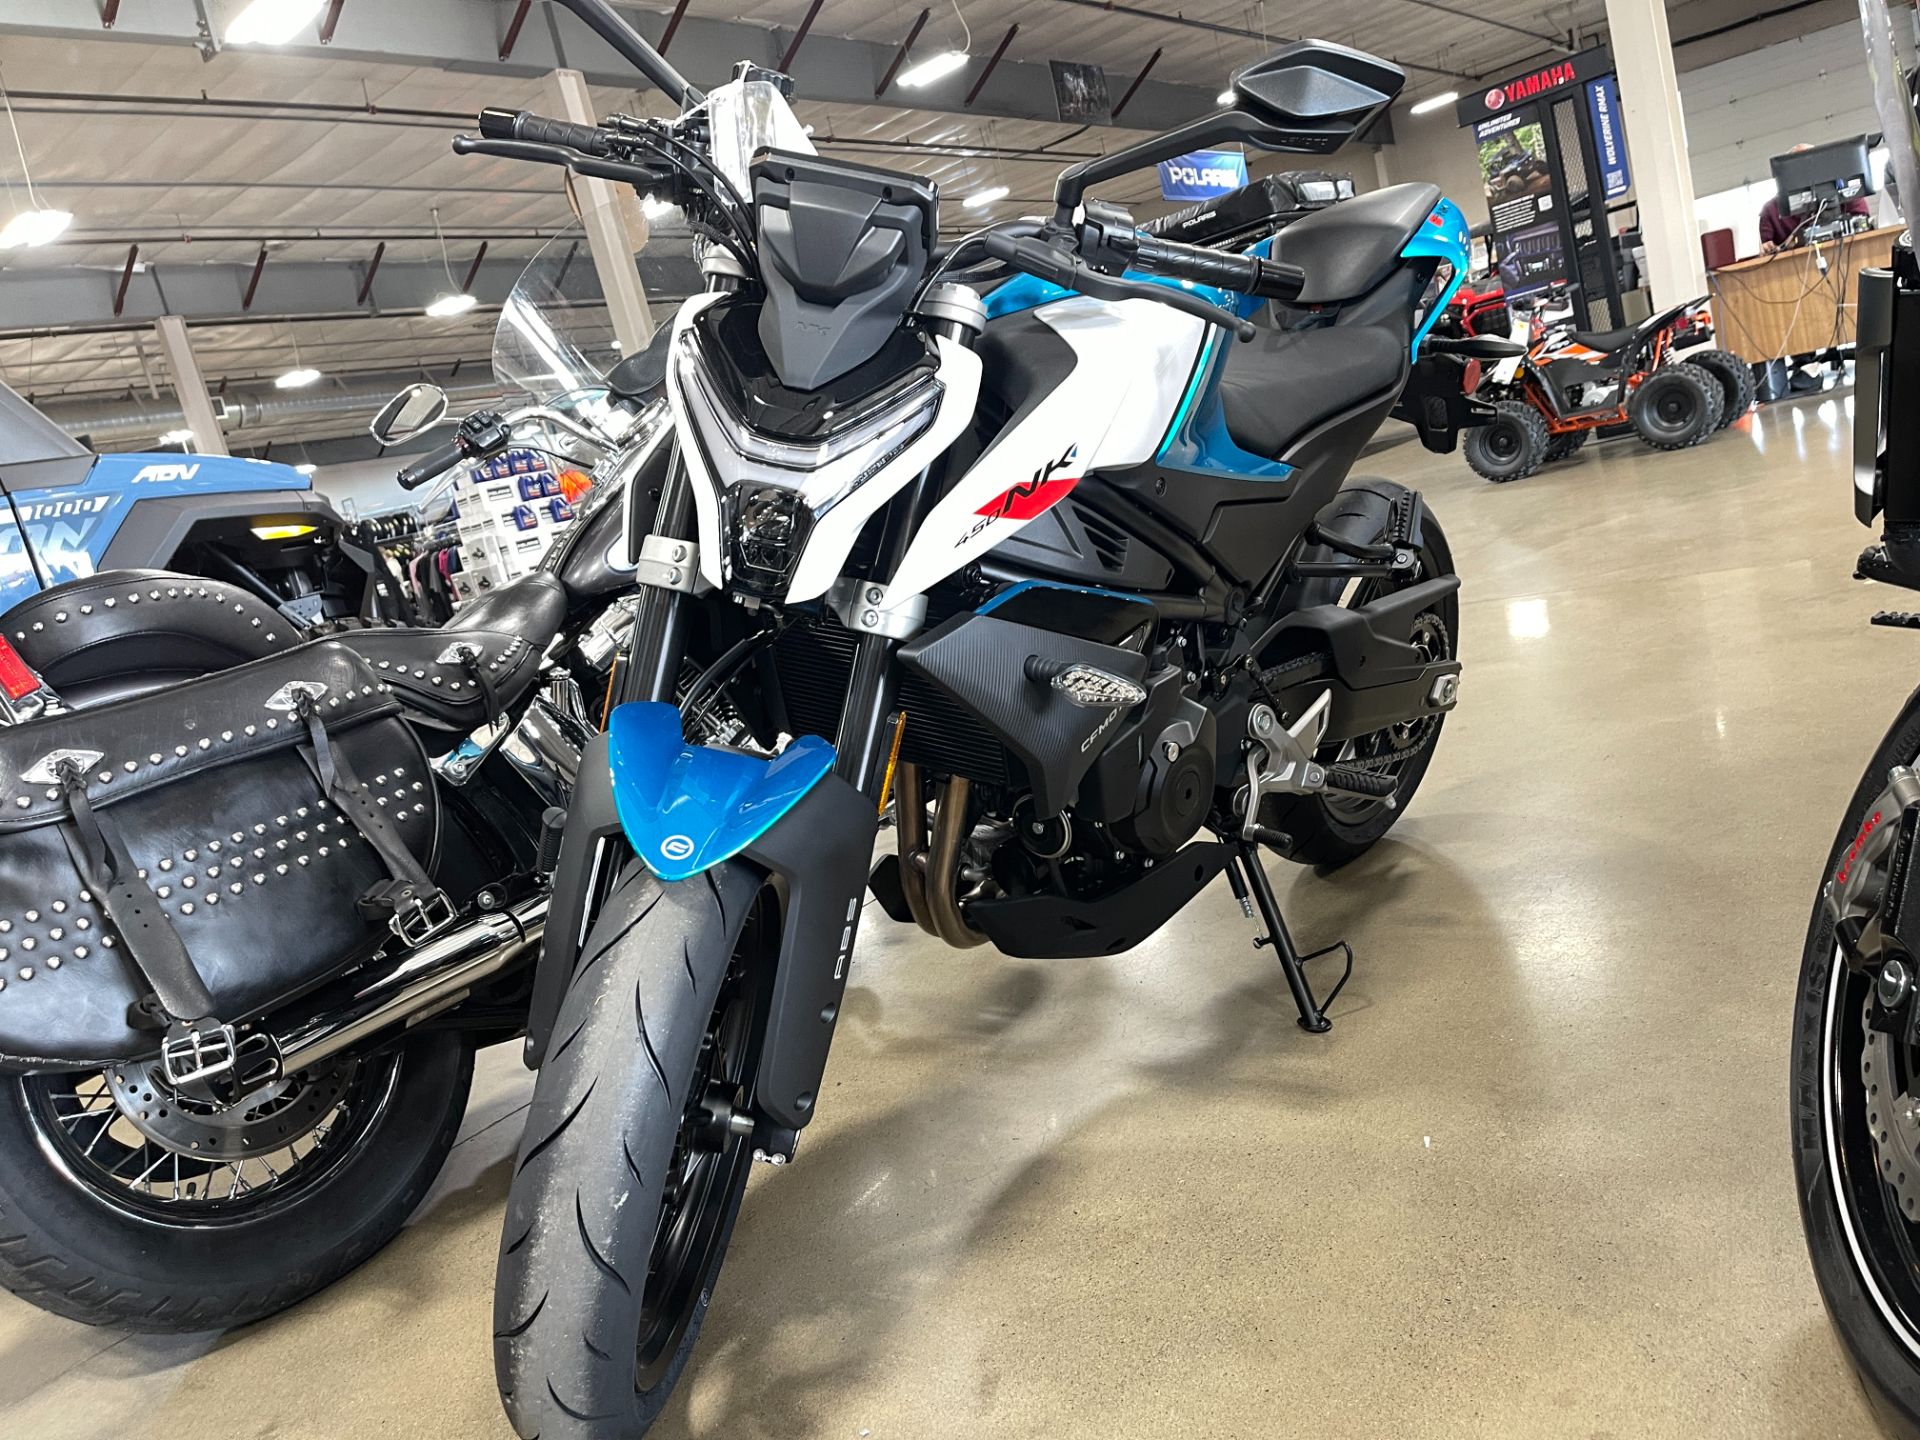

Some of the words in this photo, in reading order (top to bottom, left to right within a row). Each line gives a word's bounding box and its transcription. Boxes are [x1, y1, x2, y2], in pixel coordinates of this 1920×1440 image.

[1504, 61, 1576, 103] YAMAHA
[1594, 85, 1608, 113] RMAX
[1600, 113, 1617, 165] WOLVERINE
[1168, 166, 1239, 188] POLARIS
[1182, 210, 1217, 229] POLARIS
[131, 463, 201, 484] ADV
[1836, 811, 1882, 884] brembo
[833, 897, 857, 980] ABS
